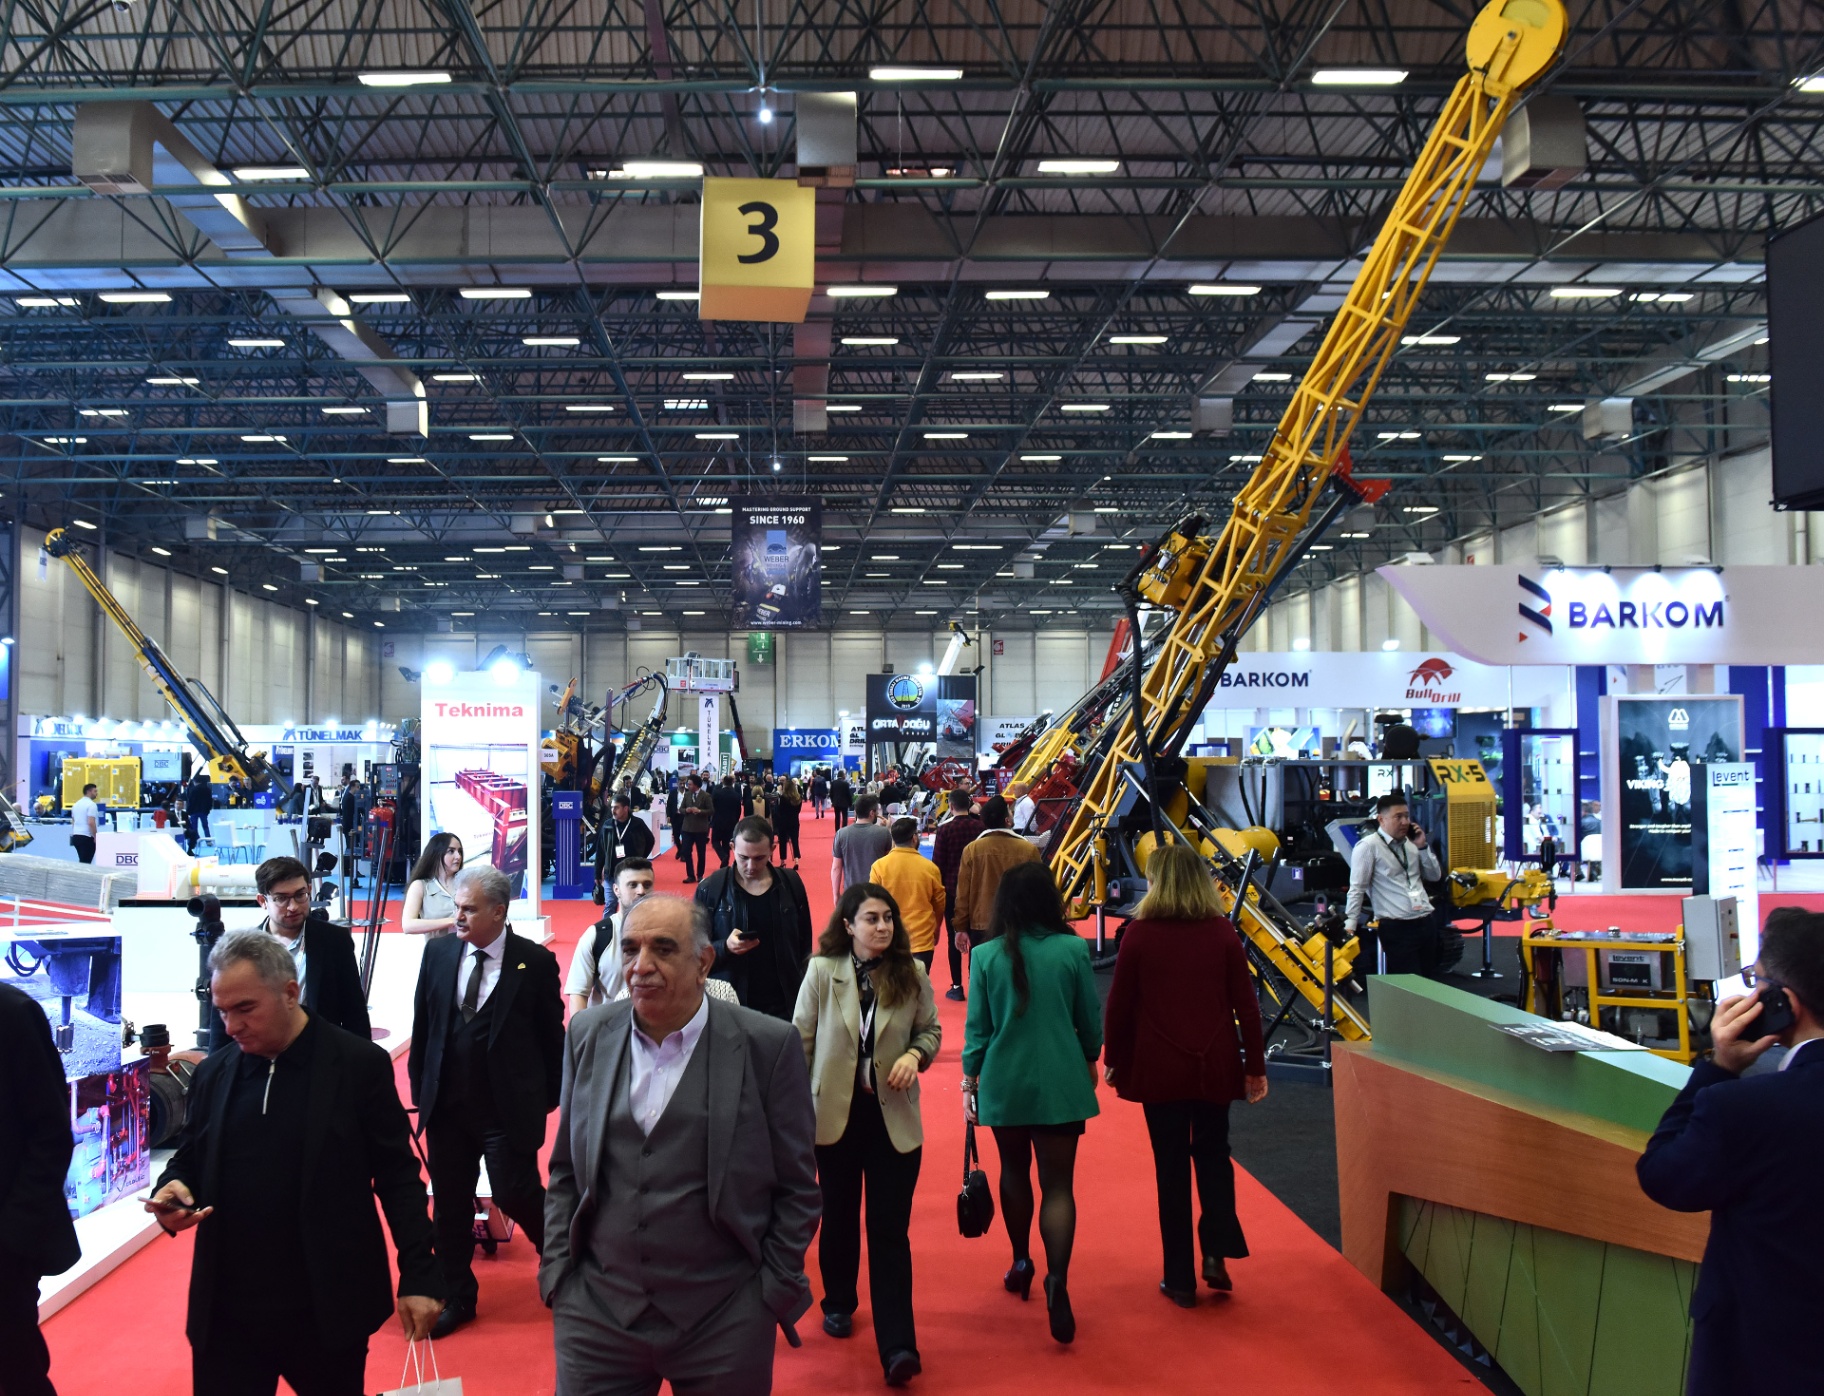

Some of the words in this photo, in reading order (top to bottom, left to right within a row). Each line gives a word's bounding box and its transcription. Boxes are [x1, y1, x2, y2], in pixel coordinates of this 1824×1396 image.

[737, 201, 779, 264] 3
[749, 515, 779, 525] SINCE
[781, 515, 805, 525] 1960
[1568, 601, 1725, 628] BARKOM
[1220, 672, 1309, 687] BARKOM
[435, 703, 524, 717] Teknima
[872, 719, 899, 729] ORTA
[903, 718, 931, 731] DOĞU
[298, 729, 363, 741] TÜNELMAK
[1437, 764, 1486, 783] RX-5
[1627, 780, 1664, 790] VIKING
